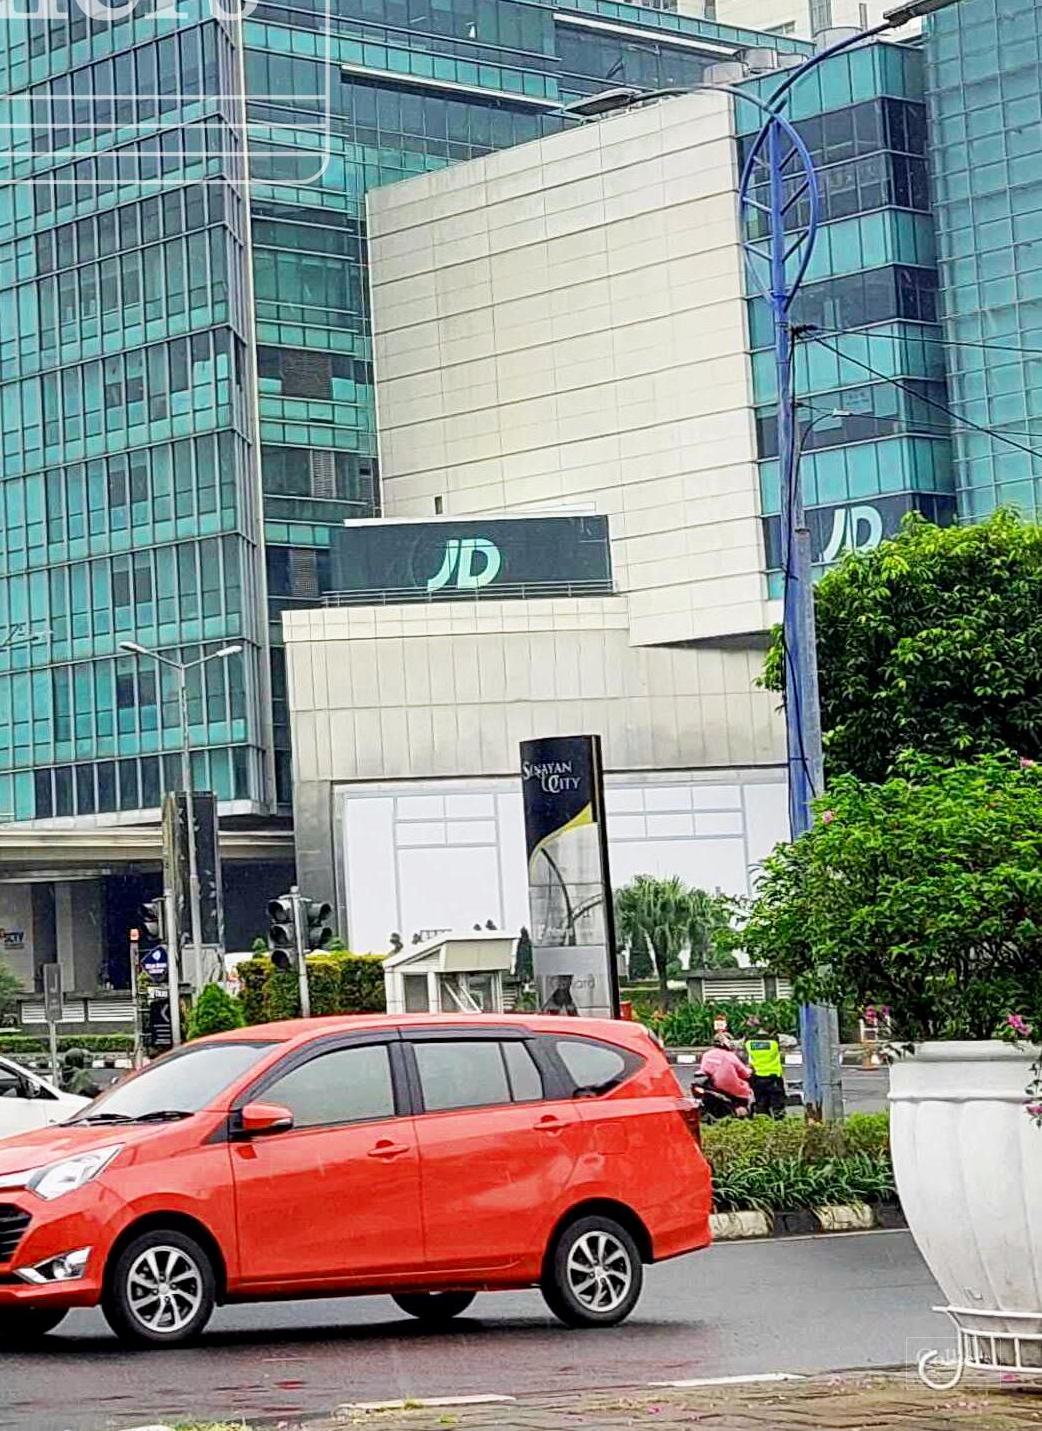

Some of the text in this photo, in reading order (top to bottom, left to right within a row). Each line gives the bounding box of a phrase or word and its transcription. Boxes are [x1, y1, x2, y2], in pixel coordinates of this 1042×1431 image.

[819, 505, 882, 563] JD
[427, 538, 501, 591] JD
[542, 774, 582, 793] CITY
